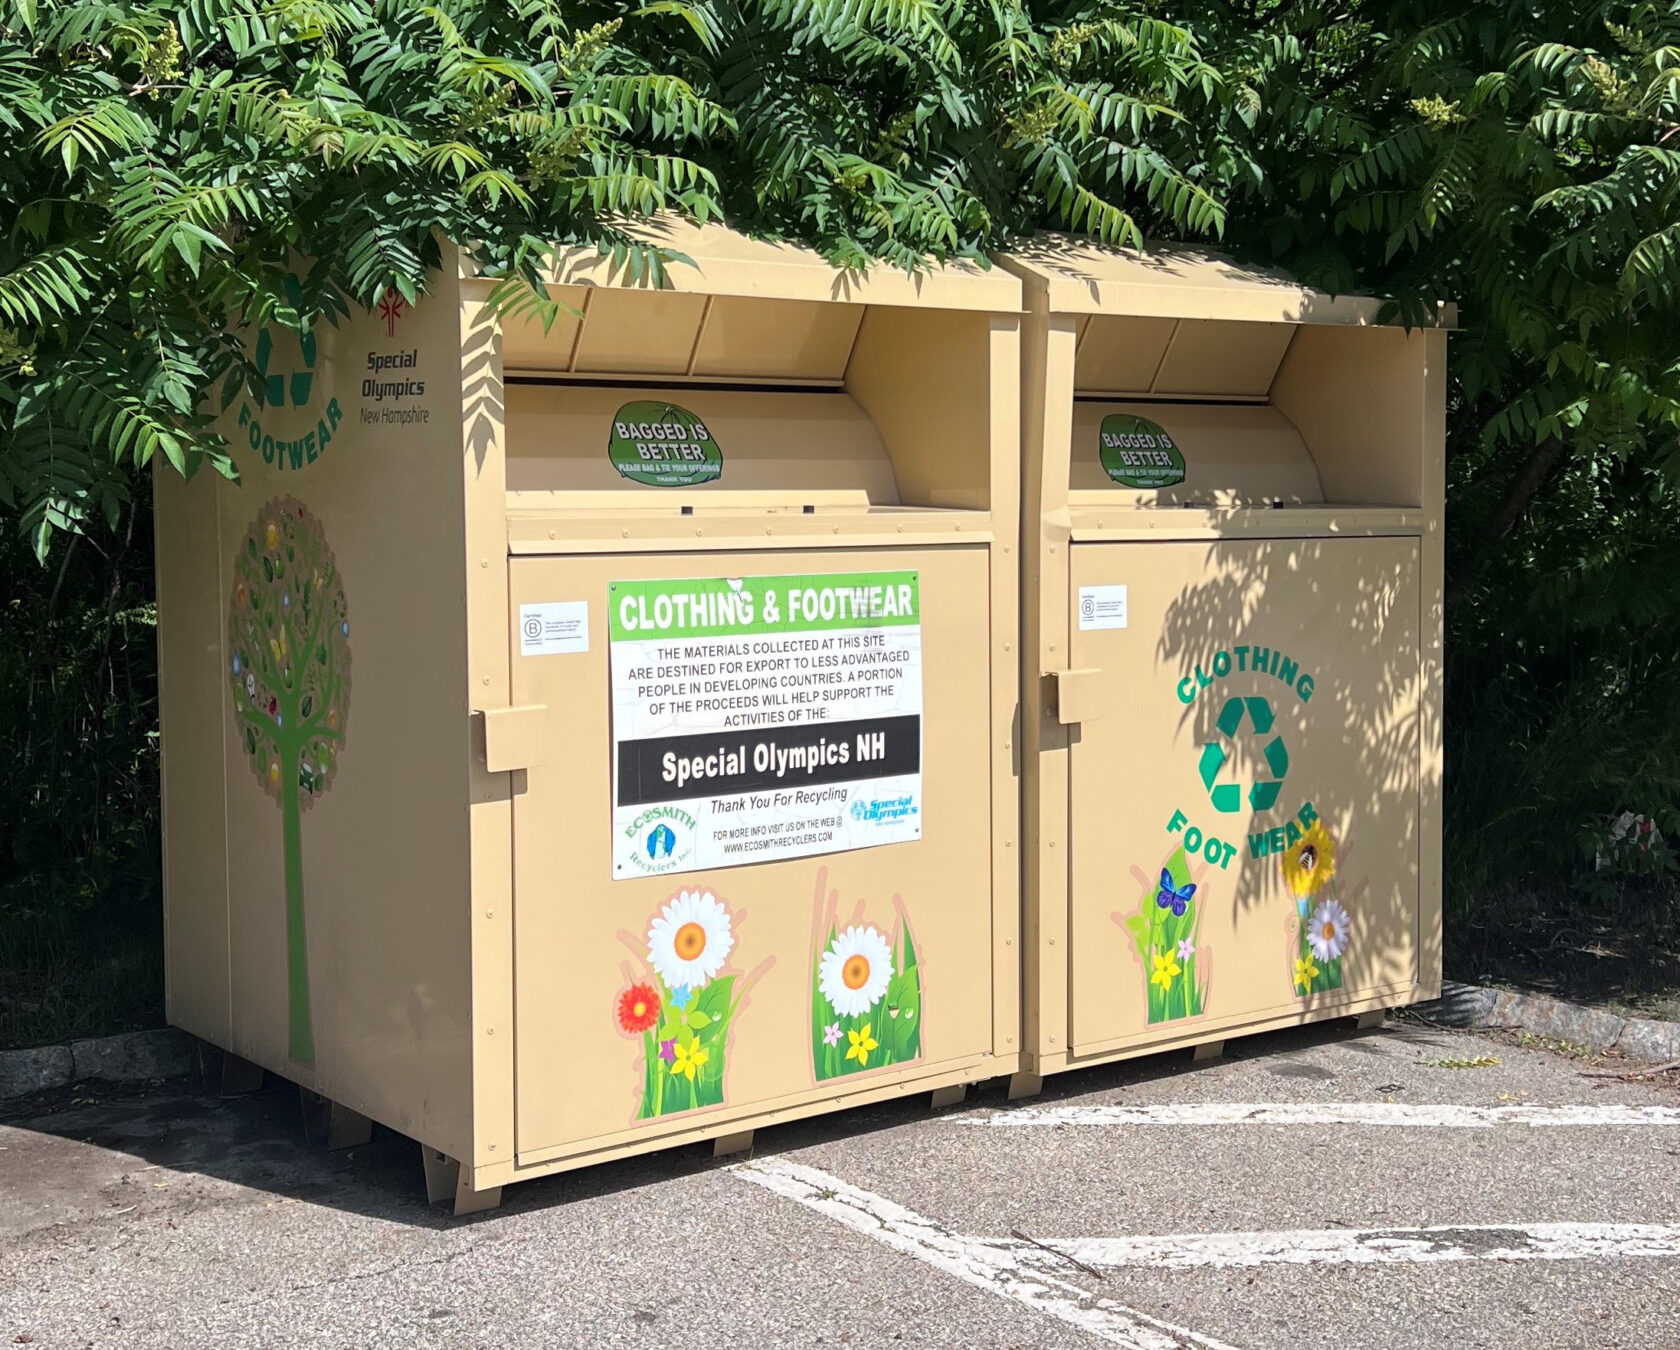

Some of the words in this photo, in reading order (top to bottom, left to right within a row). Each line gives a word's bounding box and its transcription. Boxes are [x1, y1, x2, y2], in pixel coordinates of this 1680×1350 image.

[367, 349, 417, 374] Special
[362, 378, 425, 401] Olympics
[360, 408, 379, 424] New
[382, 407, 429, 427] Hampshire
[238, 397, 343, 470] FOOTWEAR
[615, 422, 687, 440] BAGGED
[690, 424, 709, 441] IS
[1101, 433, 1156, 448] BAGGED
[1157, 434, 1173, 449] IS
[636, 443, 706, 460] BETTER
[1120, 451, 1173, 466] BETTER
[619, 463, 641, 472] PLEASE
[642, 463, 655, 472] BAG
[661, 464, 671, 472] TIE
[672, 464, 688, 472] YOUR
[688, 464, 720, 473] OFFERINGS
[620, 591, 754, 630] CLOTHING
[762, 589, 780, 624] &
[788, 584, 913, 623] FOOTWEAR
[658, 648, 680, 660] THE
[684, 643, 750, 659] MATERIALS
[753, 639, 819, 654] COLLECTED
[821, 638, 835, 650] AT
[837, 636, 860, 649] THIS
[863, 635, 885, 648] SITE
[628, 667, 653, 680] ARE
[657, 663, 716, 679] DESTINED
[719, 661, 743, 674] FOR
[746, 658, 791, 673] EXPORT
[794, 657, 809, 669] TO
[811, 655, 839, 668] LESS
[841, 650, 910, 666] ADVANTAGED
[1177, 645, 1315, 704] CLOTHING
[638, 683, 686, 698] PEOPLE
[689, 682, 701, 694] IN
[704, 676, 778, 693] DEVELOPING
[847, 671, 855, 682] A
[857, 667, 903, 681] PORTION
[649, 703, 665, 716] OF
[669, 700, 692, 714] THE
[696, 695, 759, 712] PROCEEDS
[761, 693, 789, 707] WILL
[791, 690, 820, 704] HELP
[822, 686, 872, 702] SUPPORT
[874, 685, 894, 697] THE
[724, 711, 785, 727] ACTIVITIES
[787, 709, 803, 722] OF
[662, 745, 746, 788] Special
[753, 737, 850, 778] Olympics
[856, 732, 885, 762] NH
[711, 797, 746, 814] Thank
[749, 795, 770, 811] You
[773, 792, 793, 807] For
[795, 787, 848, 806] Recycling
[870, 794, 913, 811] Special
[624, 806, 697, 839] ECOSMITH
[863, 806, 918, 821] Olympics
[713, 830, 728, 841] FOR
[728, 827, 749, 840] MORE
[750, 825, 767, 837] INFO
[767, 823, 784, 834] VISIT
[785, 822, 795, 832] US
[795, 821, 807, 832] ON
[807, 818, 820, 830] THE
[820, 817, 835, 828] WEB
[836, 816, 843, 828] @
[1166, 808, 1237, 870] FOOT
[1247, 801, 1319, 859] WEAR
[629, 851, 677, 873] Recyclers
